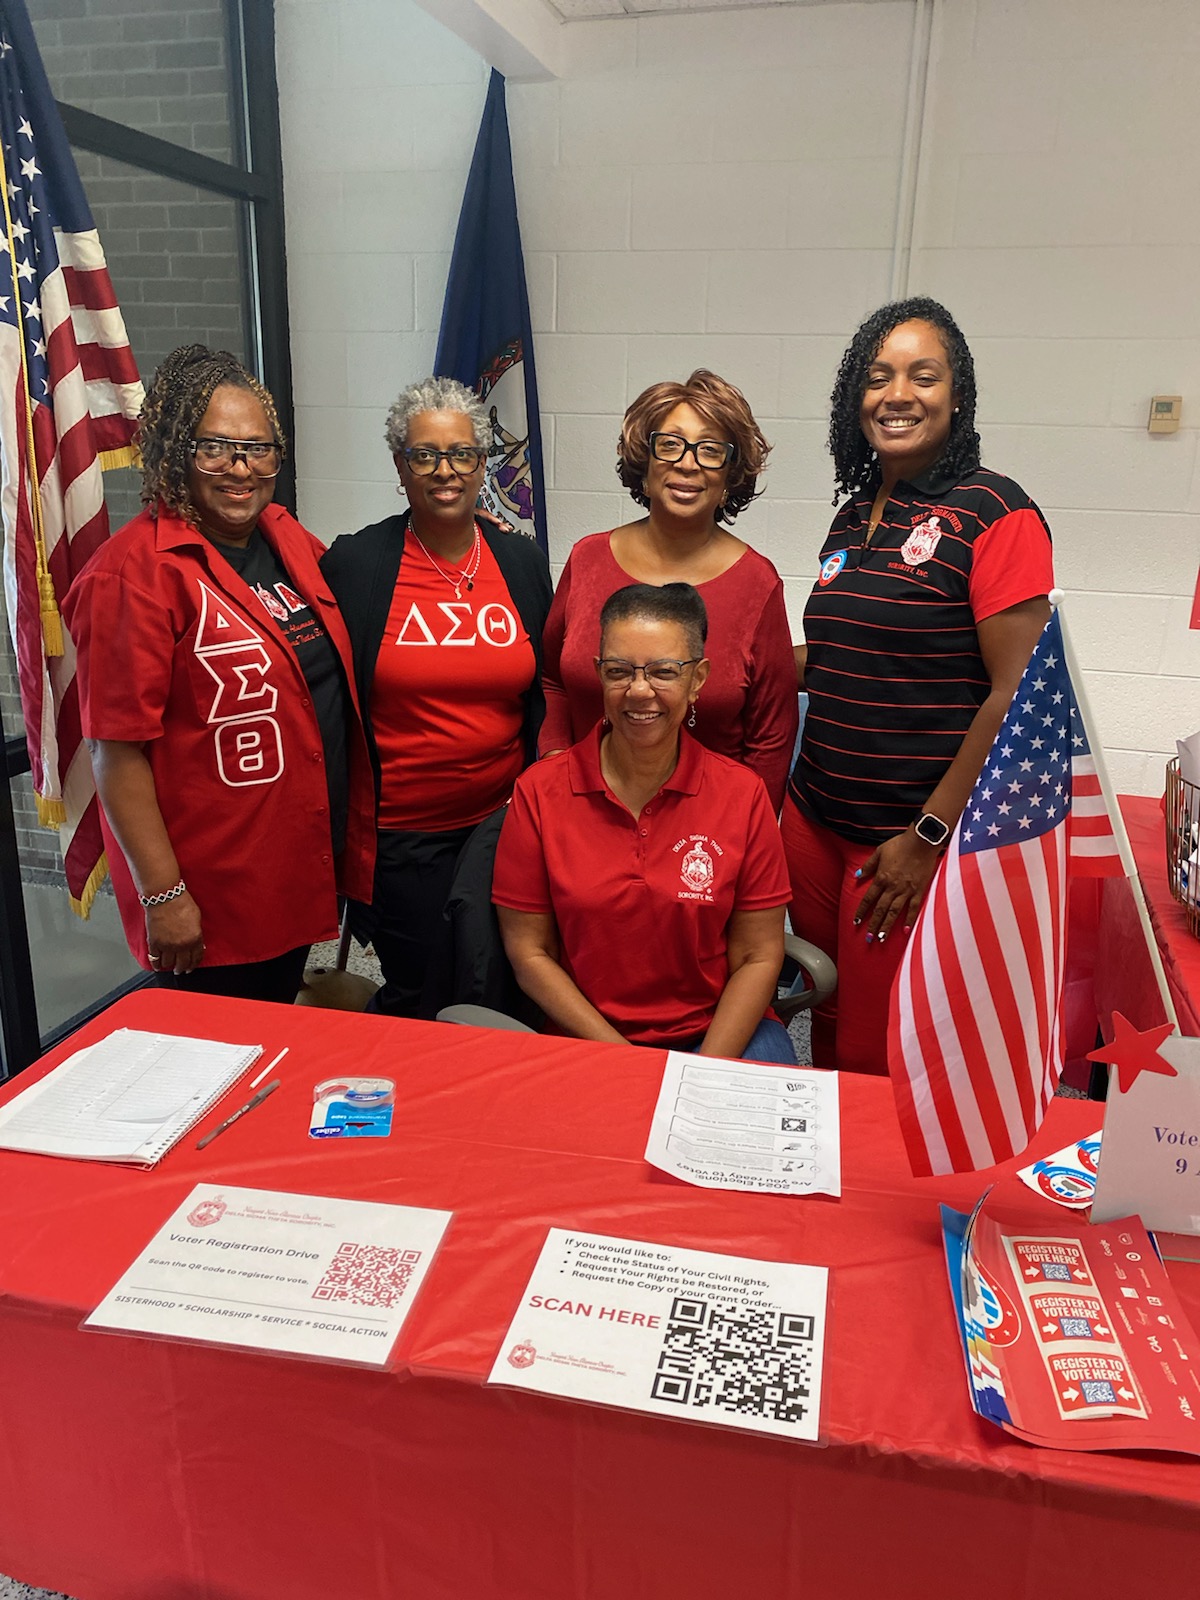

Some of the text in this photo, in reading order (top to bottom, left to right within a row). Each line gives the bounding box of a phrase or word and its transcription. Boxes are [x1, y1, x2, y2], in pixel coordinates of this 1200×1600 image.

[395, 602, 517, 647] ΔΣΘ
[672, 834, 724, 856] DELTA SIGMA THETA
[677, 1162, 708, 1175] vote?
[1175, 1158, 1188, 1175] 9
[695, 1174, 753, 1186] Elections:
[729, 1173, 762, 1181] ready
[169, 1234, 320, 1260] Voter Registration Drive
[575, 1240, 596, 1249] you
[598, 1244, 632, 1255] would
[634, 1249, 654, 1258] like
[656, 1254, 671, 1262] to:
[1018, 1245, 1080, 1257] REGISTER TO
[1025, 1254, 1079, 1265] VOTE HERE
[149, 1258, 170, 1266] Scan
[172, 1260, 187, 1268] the
[188, 1263, 202, 1271] QR
[203, 1265, 226, 1274] code
[238, 1270, 274, 1281] register
[287, 1276, 309, 1285] vote.
[575, 1260, 617, 1273] Request
[620, 1268, 645, 1278] Your
[647, 1272, 679, 1284] Rights
[682, 1278, 695, 1286] be
[698, 1281, 749, 1296] Restored,
[579, 1251, 610, 1262] Check
[612, 1257, 629, 1265] the
[631, 1259, 665, 1271] Status
[681, 1267, 705, 1278] Your
[707, 1272, 731, 1282] Civil
[734, 1276, 770, 1288] Rights,
[572, 1270, 615, 1283] Request
[617, 1278, 635, 1287] the
[637, 1281, 665, 1293] Copy
[679, 1289, 705, 1298] your
[707, 1292, 738, 1303] Grant
[741, 1298, 782, 1309] Order...
[529, 1295, 662, 1329] SCAN HERE
[1033, 1297, 1100, 1311] REGISTER TO
[1042, 1307, 1100, 1320] VOTE HERE
[115, 1295, 388, 1338] SISTERHOOD SCHOLARSHIP SERVICE SOCIAL ACTION
[1053, 1357, 1124, 1371] REGISTER TO
[1062, 1369, 1123, 1382] VOTE HERE
